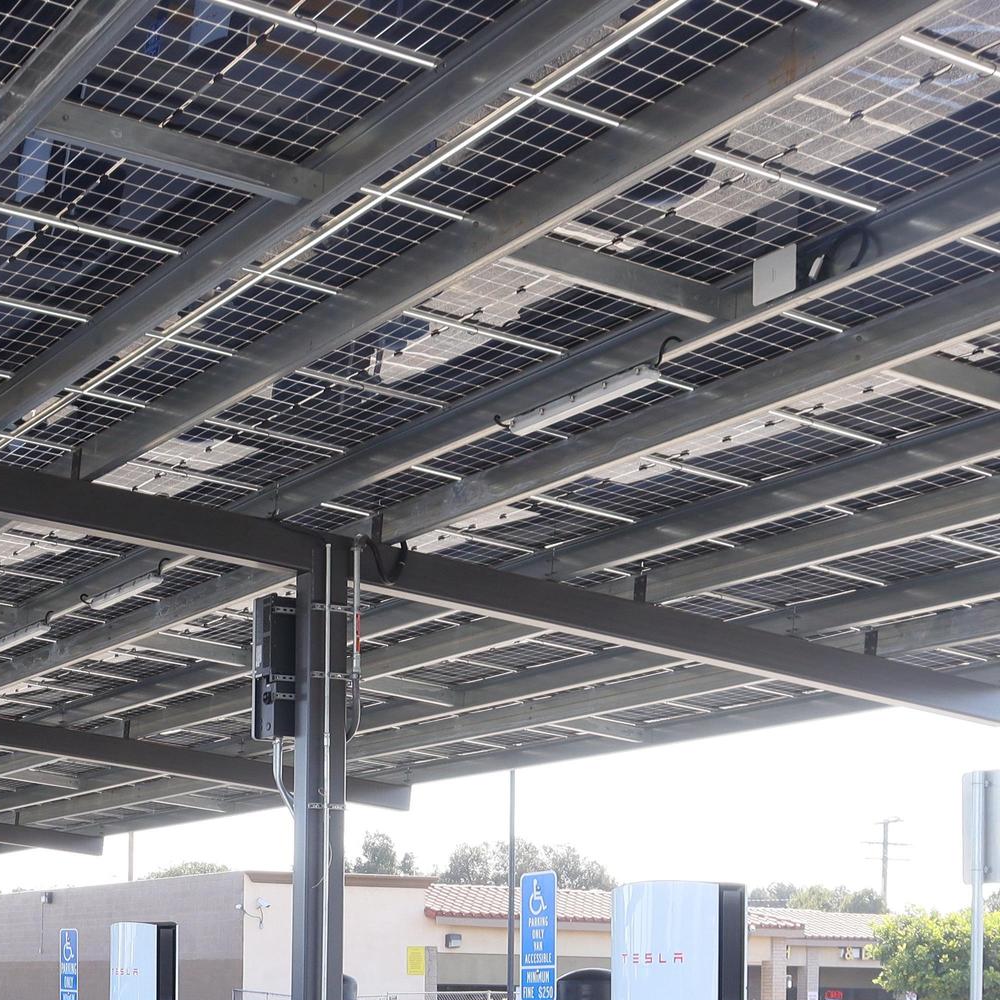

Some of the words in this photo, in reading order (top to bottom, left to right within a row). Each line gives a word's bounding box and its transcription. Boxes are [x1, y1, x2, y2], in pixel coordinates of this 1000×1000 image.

[528, 916, 549, 928] PARKING
[531, 929, 545, 940] ONLY
[533, 941, 543, 951] VAN
[524, 953, 552, 964] ACCESSIBLE
[621, 952, 683, 963] TESLA
[526, 970, 550, 983] MINIMUM
[523, 986, 535, 999] FINE
[538, 986, 553, 999] $250
